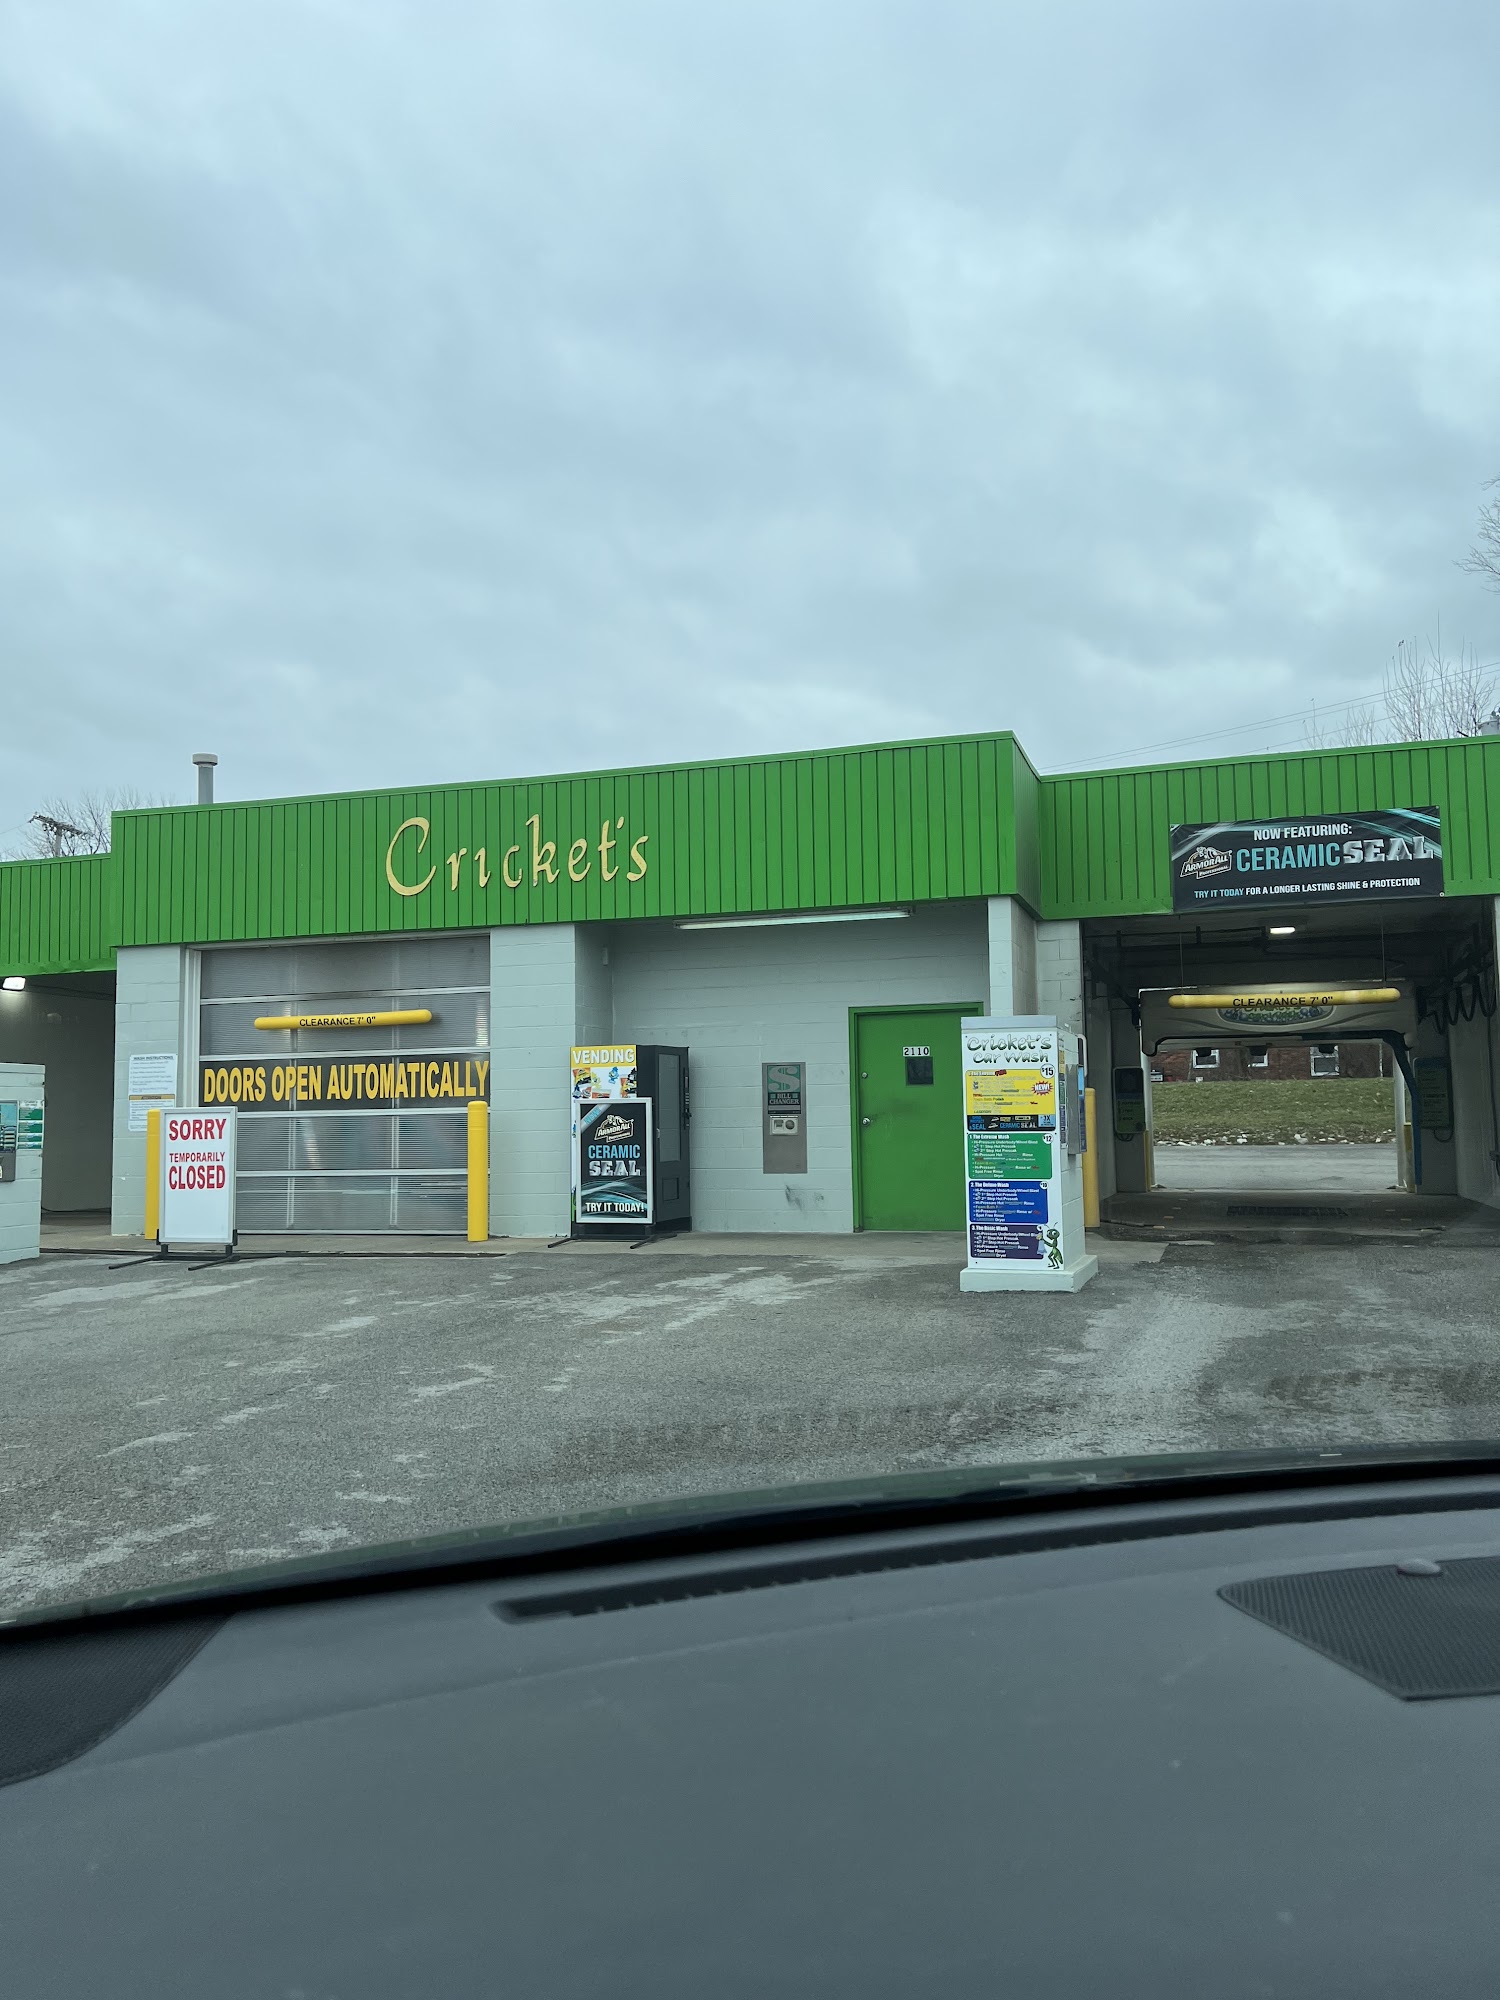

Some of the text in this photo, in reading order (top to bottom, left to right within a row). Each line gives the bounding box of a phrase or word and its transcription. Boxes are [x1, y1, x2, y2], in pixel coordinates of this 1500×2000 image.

[1254, 823, 1352, 841] NOW FEATURING:
[386, 814, 649, 896] Cricket's
[1236, 836, 1434, 872] CERAMIC SEAL
[1194, 878, 1420, 898] TRY IT TODAY FOR A LONGER LASTING SHINE & PROTECTION
[1232, 997, 1306, 1007] CLEARANCE
[1310, 997, 1319, 1005] 7'
[300, 1017, 356, 1026] CLEARANCE
[357, 1016, 364, 1024] 7'
[967, 1034, 1052, 1051] Cricket's
[573, 1048, 635, 1064] VENDING
[904, 1046, 929, 1056] 2110
[973, 1050, 1049, 1063] Car Wash
[204, 1066, 266, 1102] DOORS
[271, 1065, 322, 1101] OPEN
[327, 1060, 488, 1100] AUTOMATICALLY
[169, 1119, 226, 1140] SORRY
[170, 1152, 226, 1162] TEMPORARILY
[588, 1145, 640, 1158] CERAMIC
[589, 1160, 641, 1176] SEAL
[169, 1165, 226, 1190] CLOSED
[586, 1202, 644, 1212] TRY IT TODAY!
